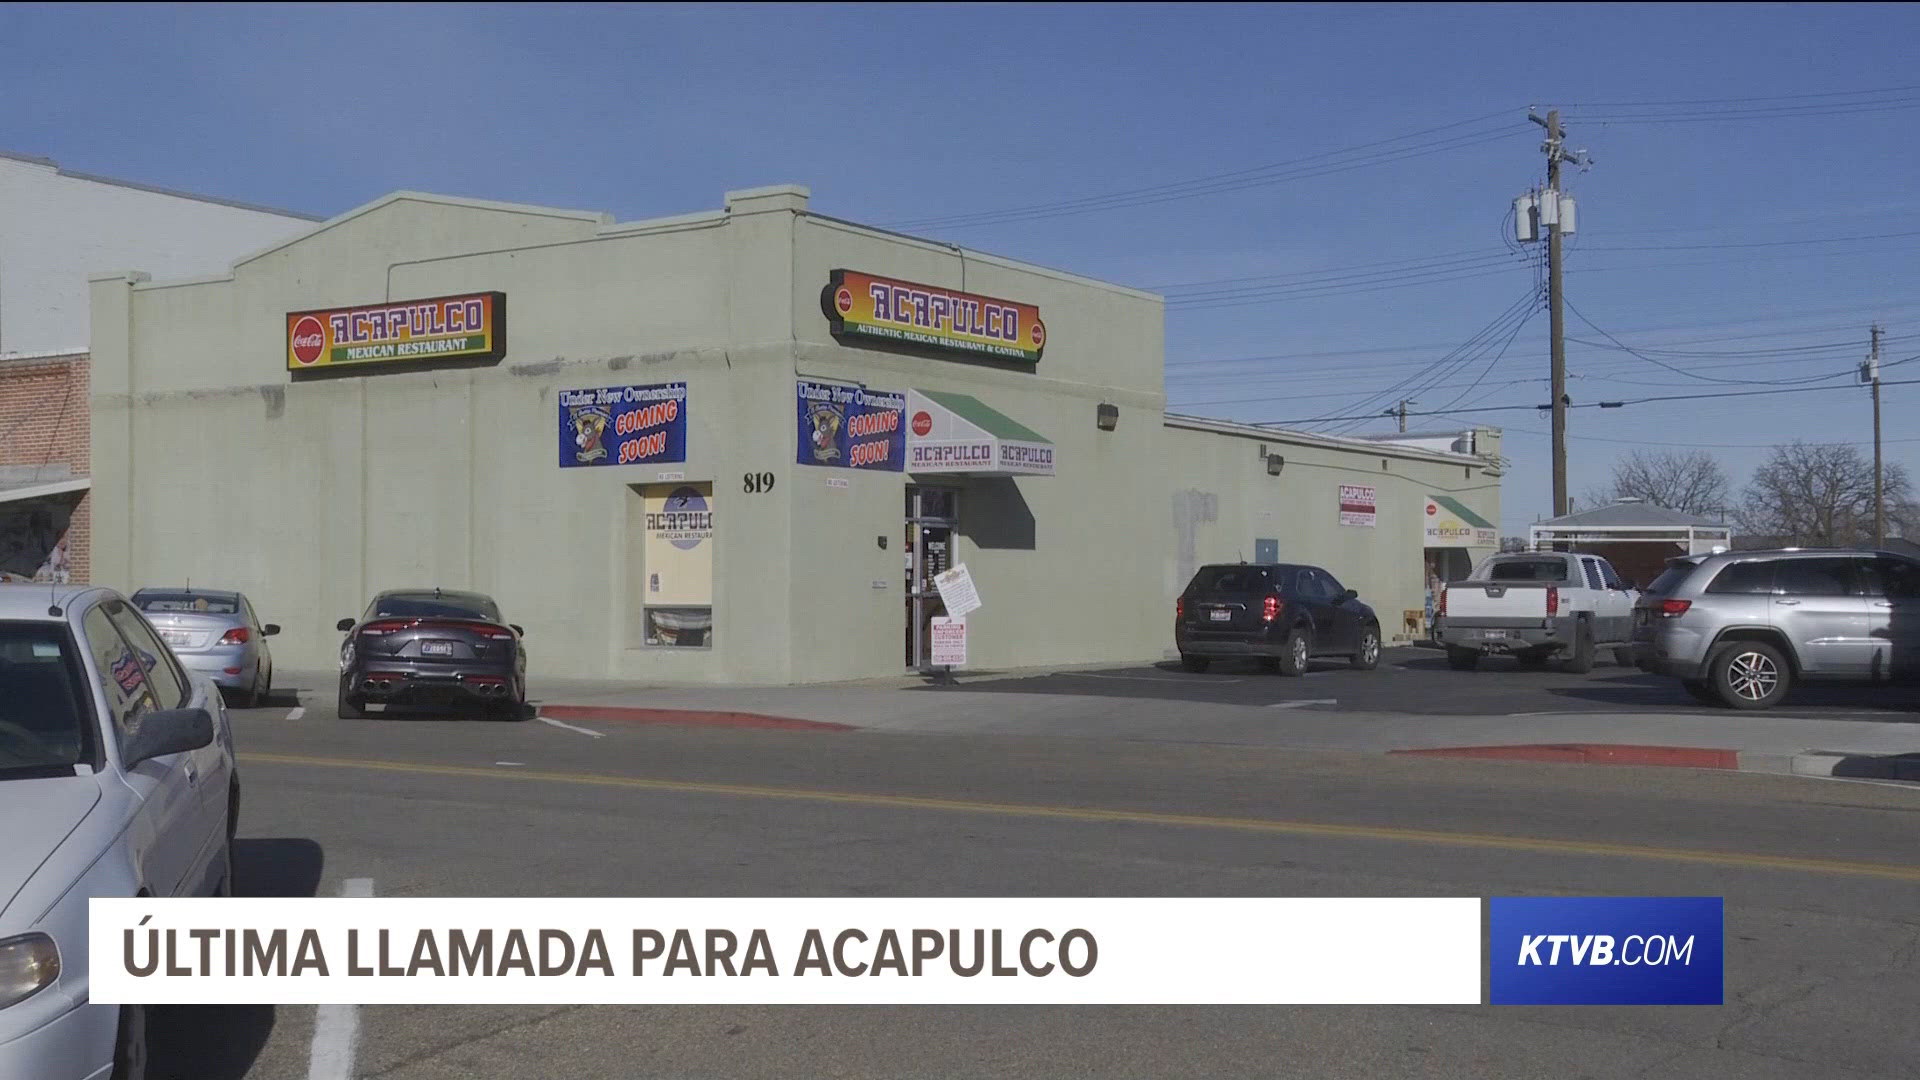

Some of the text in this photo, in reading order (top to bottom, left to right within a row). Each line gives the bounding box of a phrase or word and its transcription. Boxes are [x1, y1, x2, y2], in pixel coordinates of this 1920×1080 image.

[329, 299, 484, 345] ACAPULCO
[870, 283, 1018, 343] ACAPULCO
[347, 338, 467, 360] MEXICAN RESTAURANT
[857, 324, 1025, 357] AUTHENTIC MEXICAN RESTAURANT & CANTINA
[560, 383, 686, 407] Under New Ownership
[798, 382, 830, 401] Under
[832, 386, 854, 404] New
[855, 389, 904, 413] Ownership
[615, 400, 678, 435] COMING
[848, 410, 898, 437] COMING
[618, 431, 666, 464] SOON!
[850, 440, 889, 467] SOON!
[913, 445, 991, 461] ACAPULCO
[1000, 444, 1052, 464] ACAPULCO
[743, 472, 775, 493] 819
[1341, 486, 1375, 500] ACAPULCO
[1427, 528, 1470, 536] ACAPULCO
